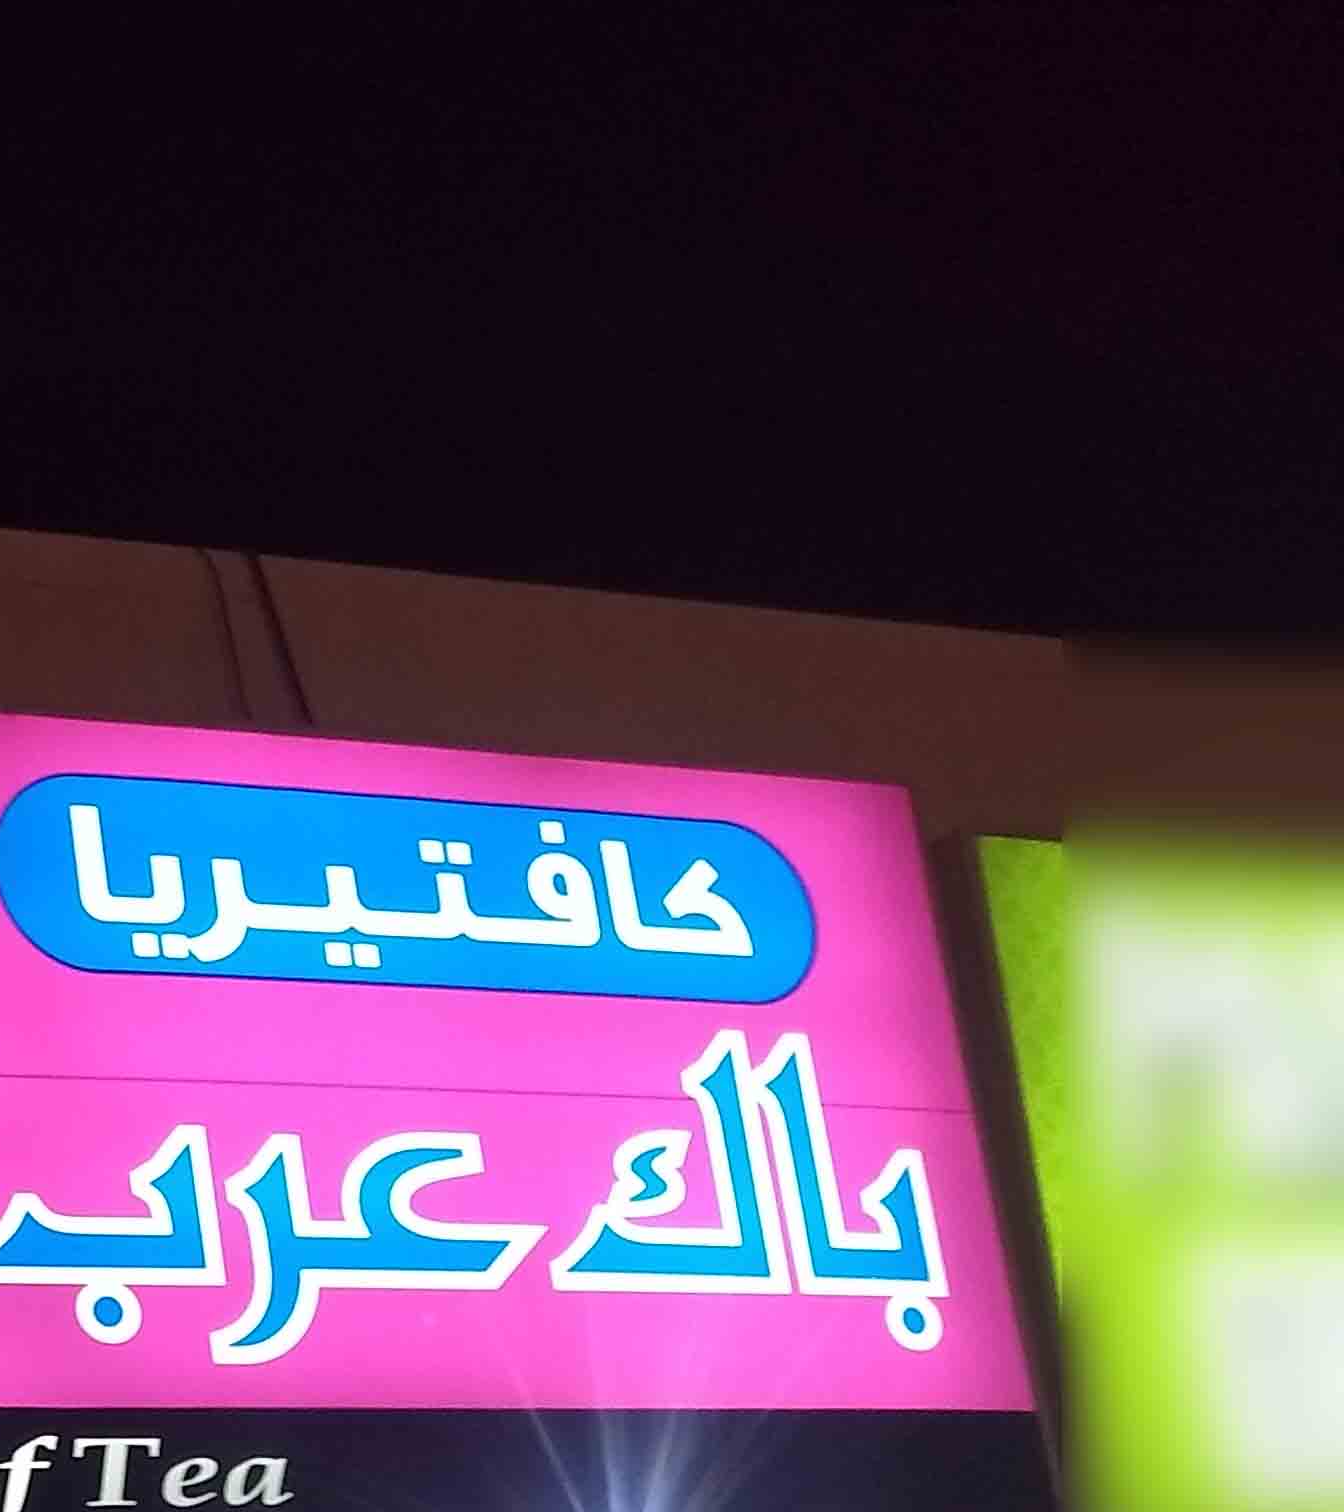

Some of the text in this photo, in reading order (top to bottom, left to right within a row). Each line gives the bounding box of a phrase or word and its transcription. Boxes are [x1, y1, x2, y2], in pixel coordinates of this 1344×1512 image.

[66, 802, 755, 966] كافتيريا
[546, 1029, 950, 1354] باك
[71, 1436, 294, 1508] Tea
